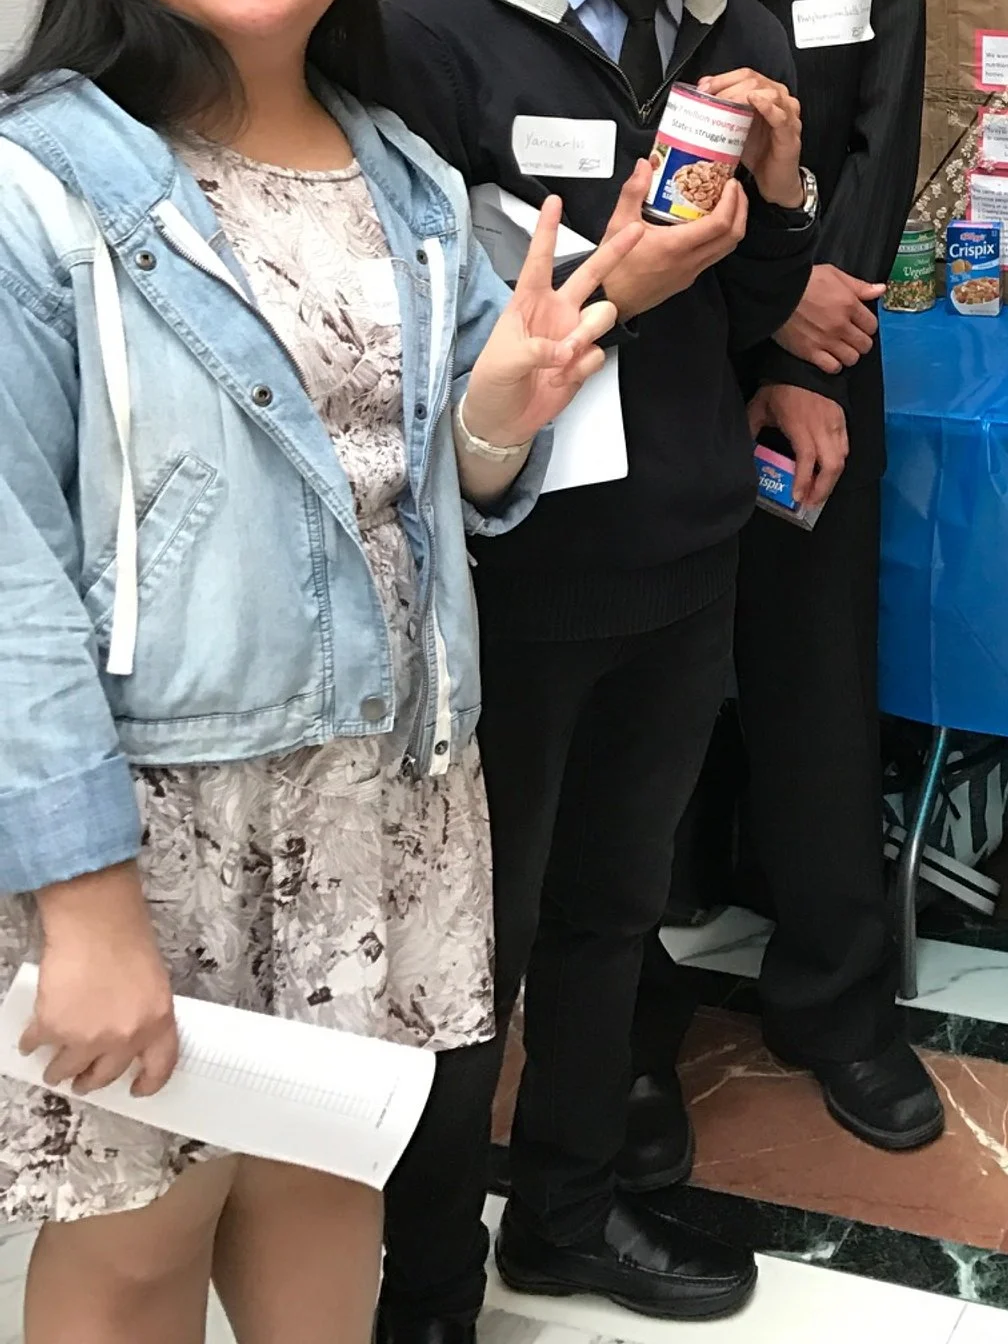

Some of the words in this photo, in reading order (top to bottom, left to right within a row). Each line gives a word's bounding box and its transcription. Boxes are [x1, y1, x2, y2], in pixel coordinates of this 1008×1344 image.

[695, 129, 726, 143] struggle
[950, 243, 994, 259] Crispix
[759, 474, 785, 492] ispix
